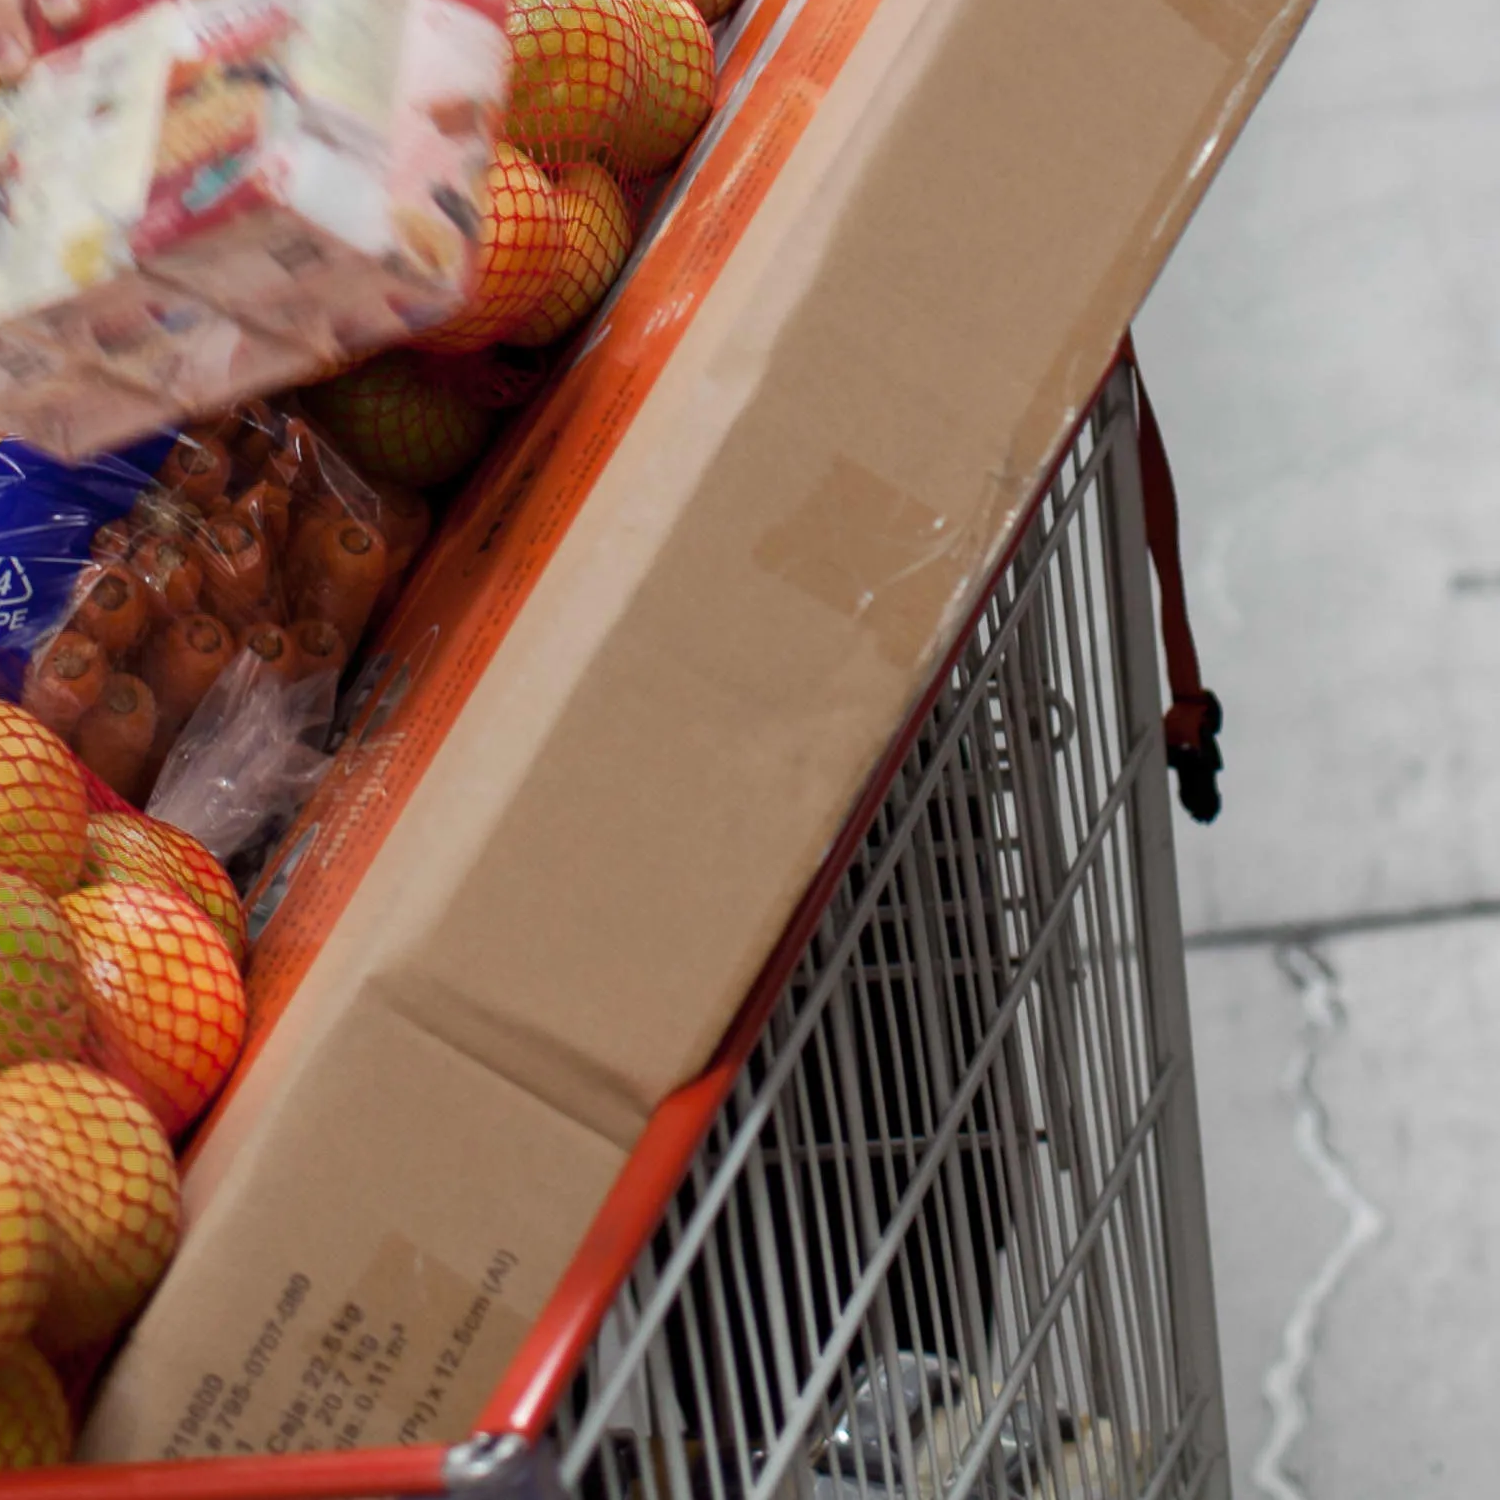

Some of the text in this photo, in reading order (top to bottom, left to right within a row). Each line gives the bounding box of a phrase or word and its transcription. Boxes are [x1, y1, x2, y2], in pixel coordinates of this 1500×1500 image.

[331, 1301, 365, 1334] kg
[350, 1333, 378, 1362] kg
[354, 1361, 390, 1411] 0.11
[426, 1384, 443, 1400] x
